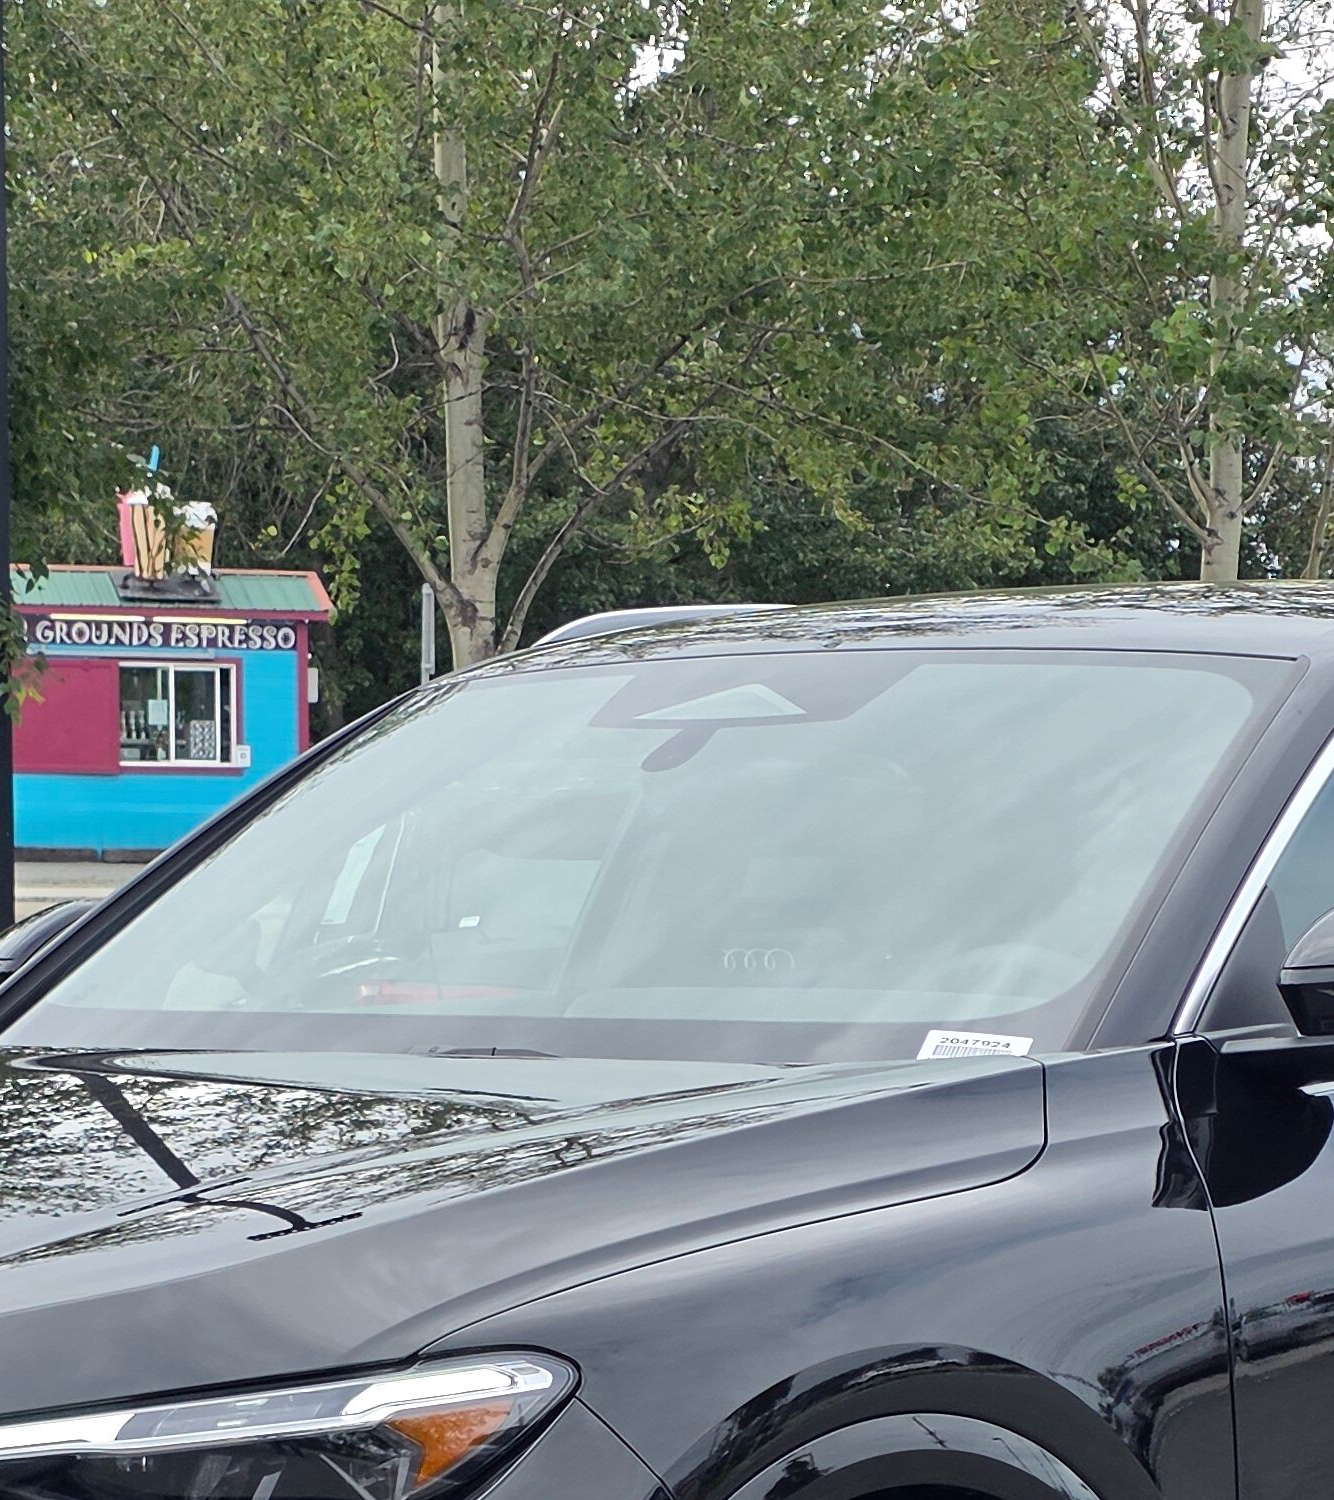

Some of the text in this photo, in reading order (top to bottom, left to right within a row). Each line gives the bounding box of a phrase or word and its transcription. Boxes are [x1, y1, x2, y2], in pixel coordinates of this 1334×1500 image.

[35, 620, 164, 647] GROUNDS
[170, 621, 297, 650] ESPRESSO
[938, 1037, 1012, 1049] 2047924
